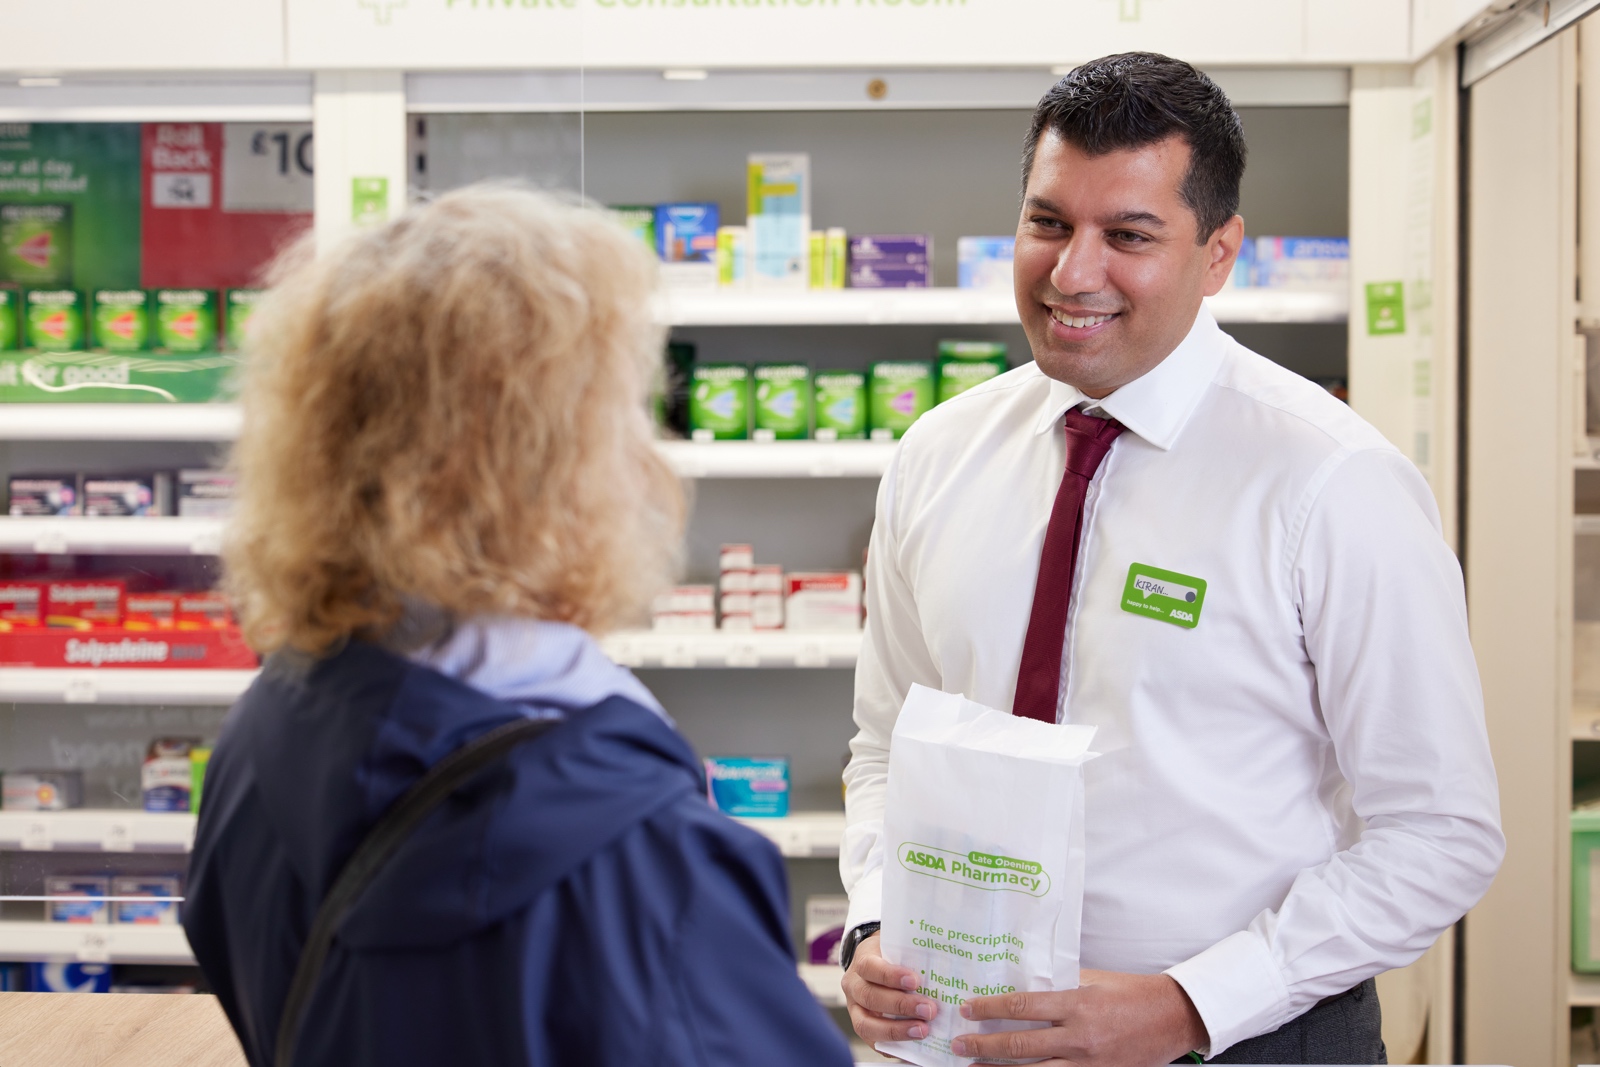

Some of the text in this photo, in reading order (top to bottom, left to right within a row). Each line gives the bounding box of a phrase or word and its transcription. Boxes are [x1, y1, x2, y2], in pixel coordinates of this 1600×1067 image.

[152, 147, 212, 169] Back
[62, 361, 129, 386] good
[1126, 599, 1142, 608] happy
[1169, 609, 1194, 622] ASDA
[905, 850, 1041, 891] ASDA Pharmacy
[972, 853, 1038, 873] Late Opening
[919, 919, 1024, 949] free prescription
[912, 937, 1020, 965] collection service
[930, 969, 1016, 996] health advice
[916, 985, 966, 1006] and info
